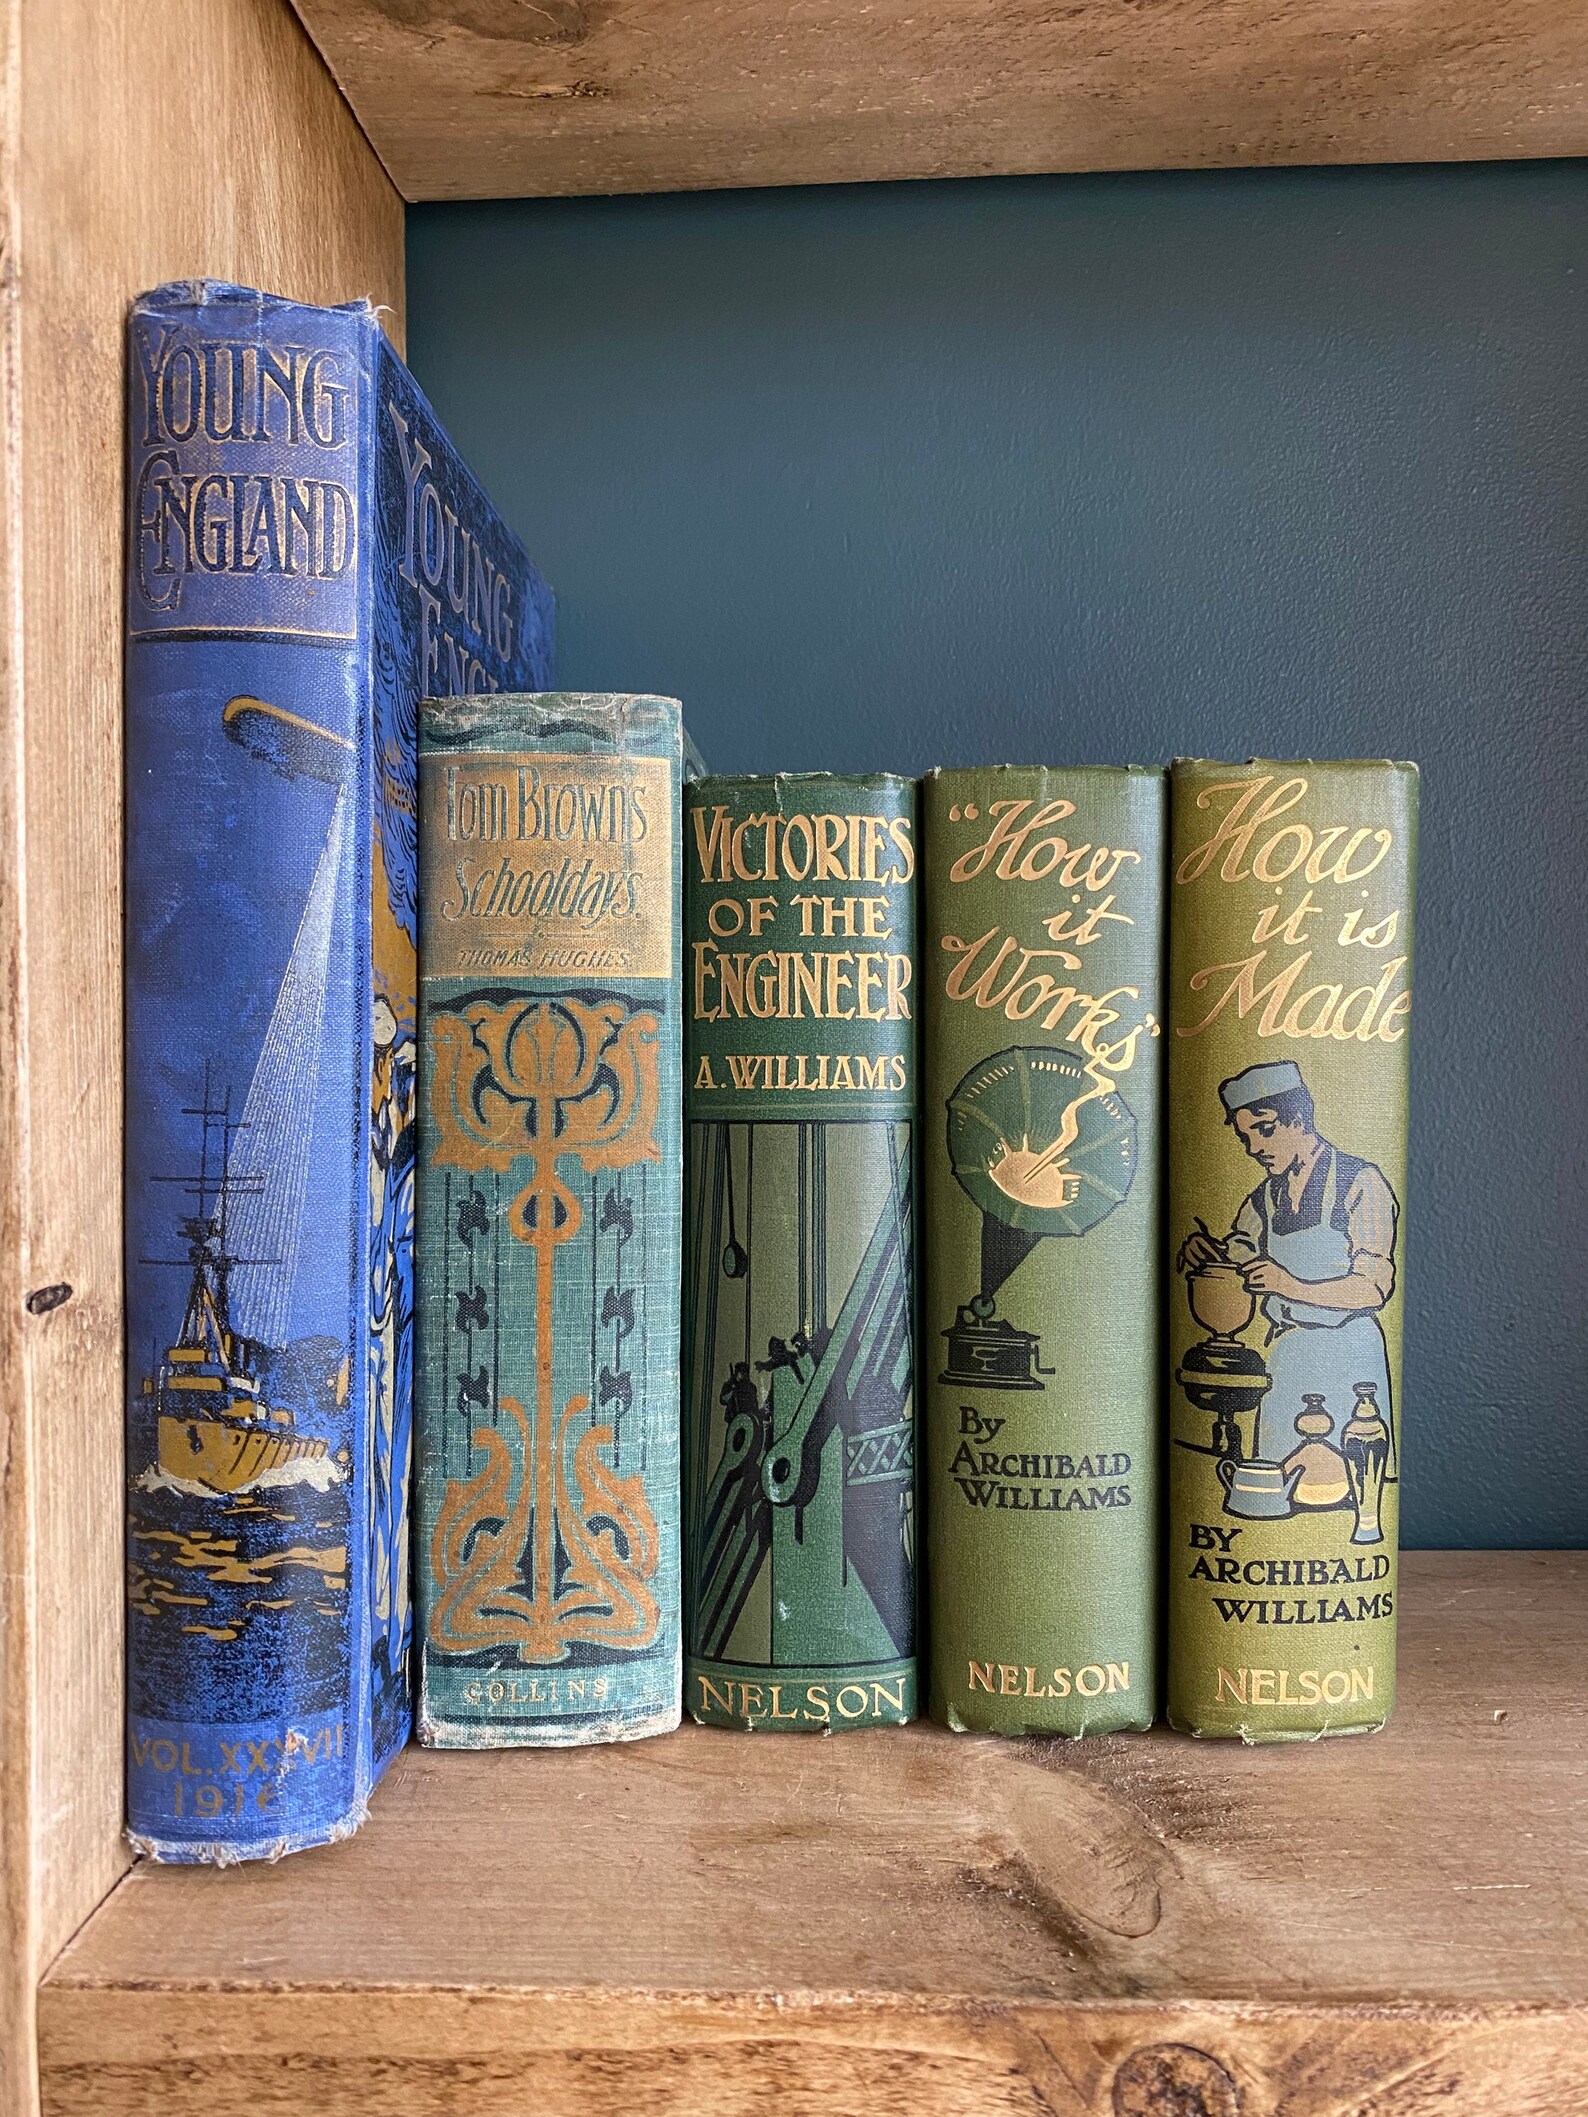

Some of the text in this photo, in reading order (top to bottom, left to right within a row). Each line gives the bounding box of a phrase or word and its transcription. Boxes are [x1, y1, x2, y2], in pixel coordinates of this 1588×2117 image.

[137, 322, 350, 450] YOUNG
[139, 450, 357, 612] ENGLAND
[389, 400, 513, 662] YOUNG
[447, 765, 509, 842] Tom
[690, 805, 914, 887] VICTORIES
[1176, 776, 1393, 884] How
[440, 857, 643, 930] Schooldays.
[708, 894, 893, 940] OF THE
[1042, 895, 1135, 945] it
[1252, 886, 1400, 949] it is
[458, 949, 532, 967] THOMAS
[691, 938, 913, 1024] ENGINEER
[1176, 950, 1412, 1042] Made
[959, 1406, 1005, 1443] By
[948, 1442, 1132, 1479] ARCHIBALD
[953, 1477, 1132, 1512] WILLIAMS
[1188, 1523, 1242, 1552] BY
[1188, 1554, 1390, 1586] ARCHIBALD
[1211, 1591, 1394, 1625] WILLIAMS
[465, 1678, 609, 1704] COLLINS
[698, 1676, 906, 1720] NELSON
[967, 1660, 1131, 1698] NELSON
[1216, 1666, 1375, 1705] NELSON
